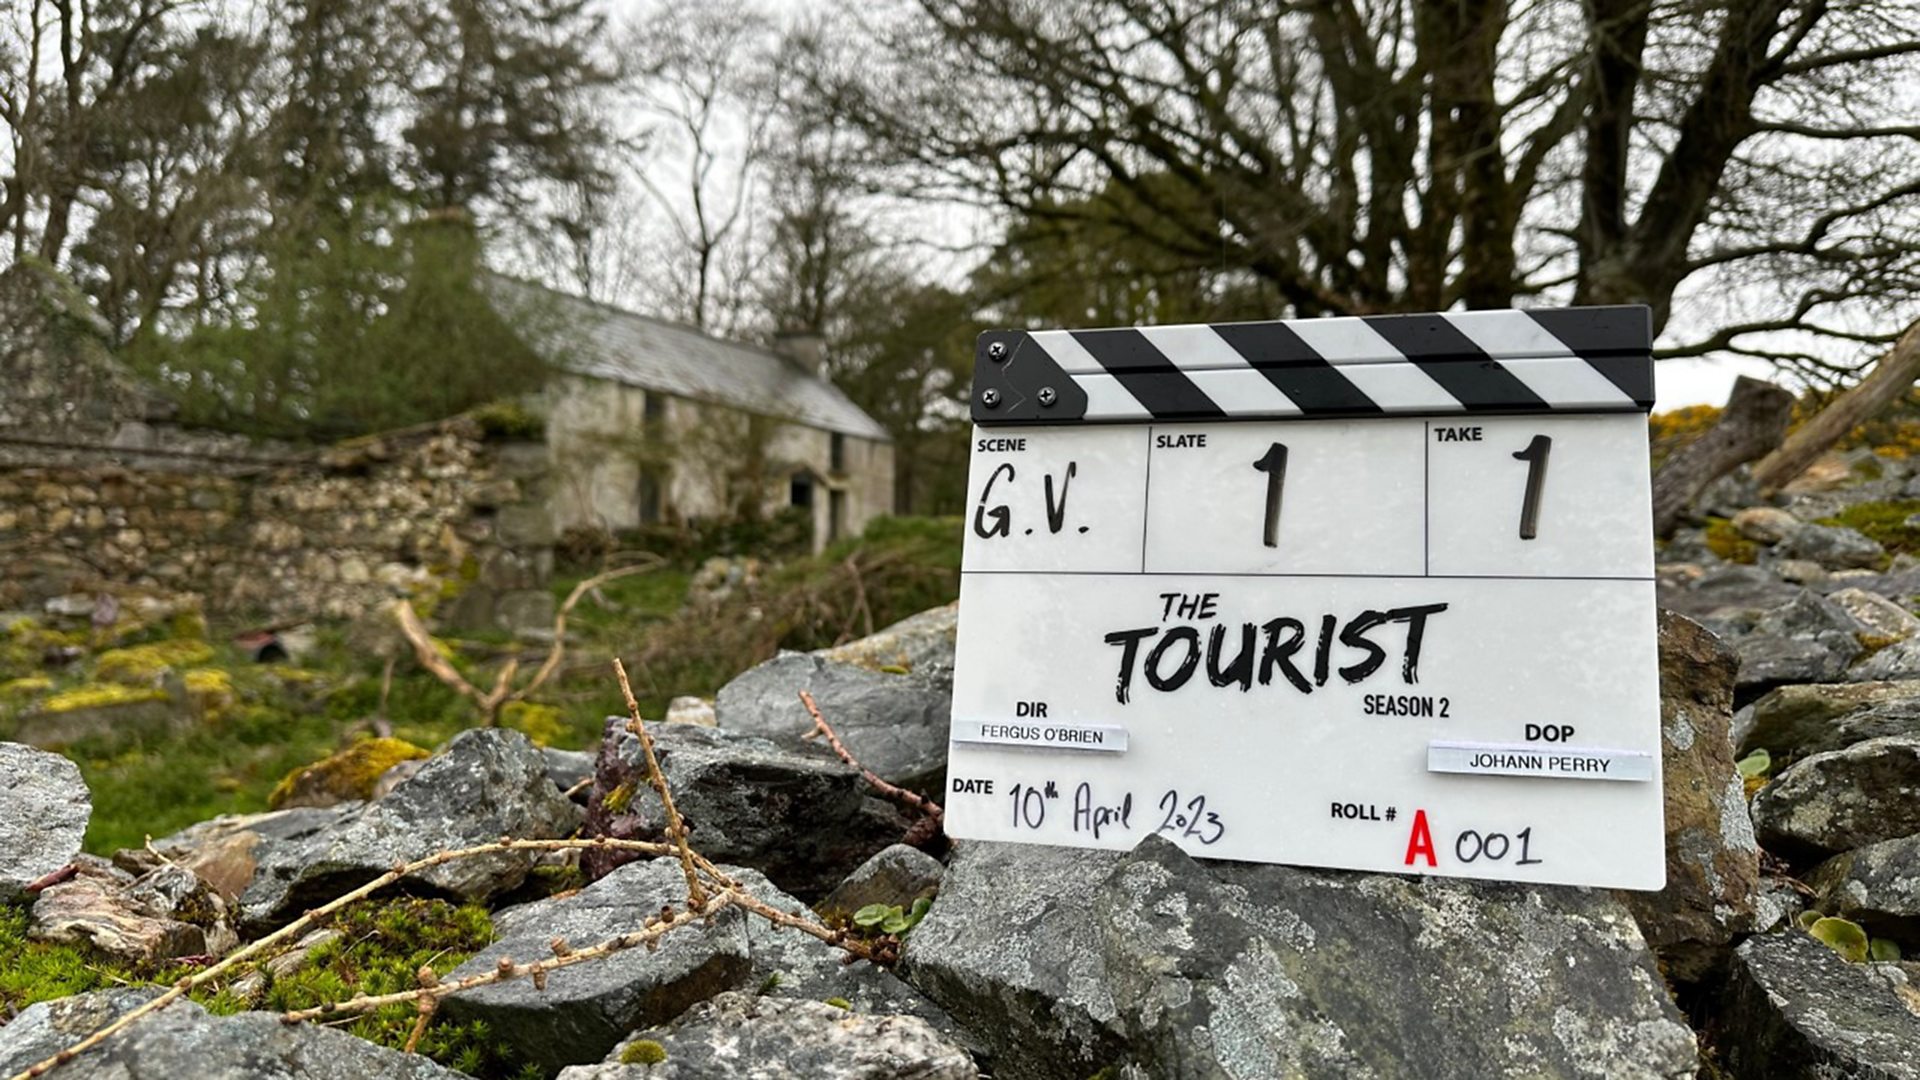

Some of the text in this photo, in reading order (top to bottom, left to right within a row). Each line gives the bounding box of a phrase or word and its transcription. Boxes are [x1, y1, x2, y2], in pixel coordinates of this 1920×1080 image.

[1156, 433, 1207, 449] SLATE
[1432, 425, 1485, 443] TAKE
[975, 437, 1028, 452] SCENE
[1252, 441, 1289, 549] 1
[1511, 434, 1553, 541] 1
[1159, 592, 1220, 622] THE
[1103, 601, 1450, 705] TOURIST
[1016, 701, 1048, 718] DIR
[1363, 693, 1450, 719] SEASON 2
[980, 725, 1103, 744] FERGUS O'BRIEN
[1525, 723, 1575, 743] DOP
[1469, 754, 1611, 773] JOHANN PERRY
[952, 778, 994, 795] DATE
[1073, 781, 1132, 840] April
[1156, 789, 1225, 846] 2023
[1331, 802, 1381, 822] ROLL
[1404, 809, 1438, 868] A
[1455, 826, 1543, 866] 001
